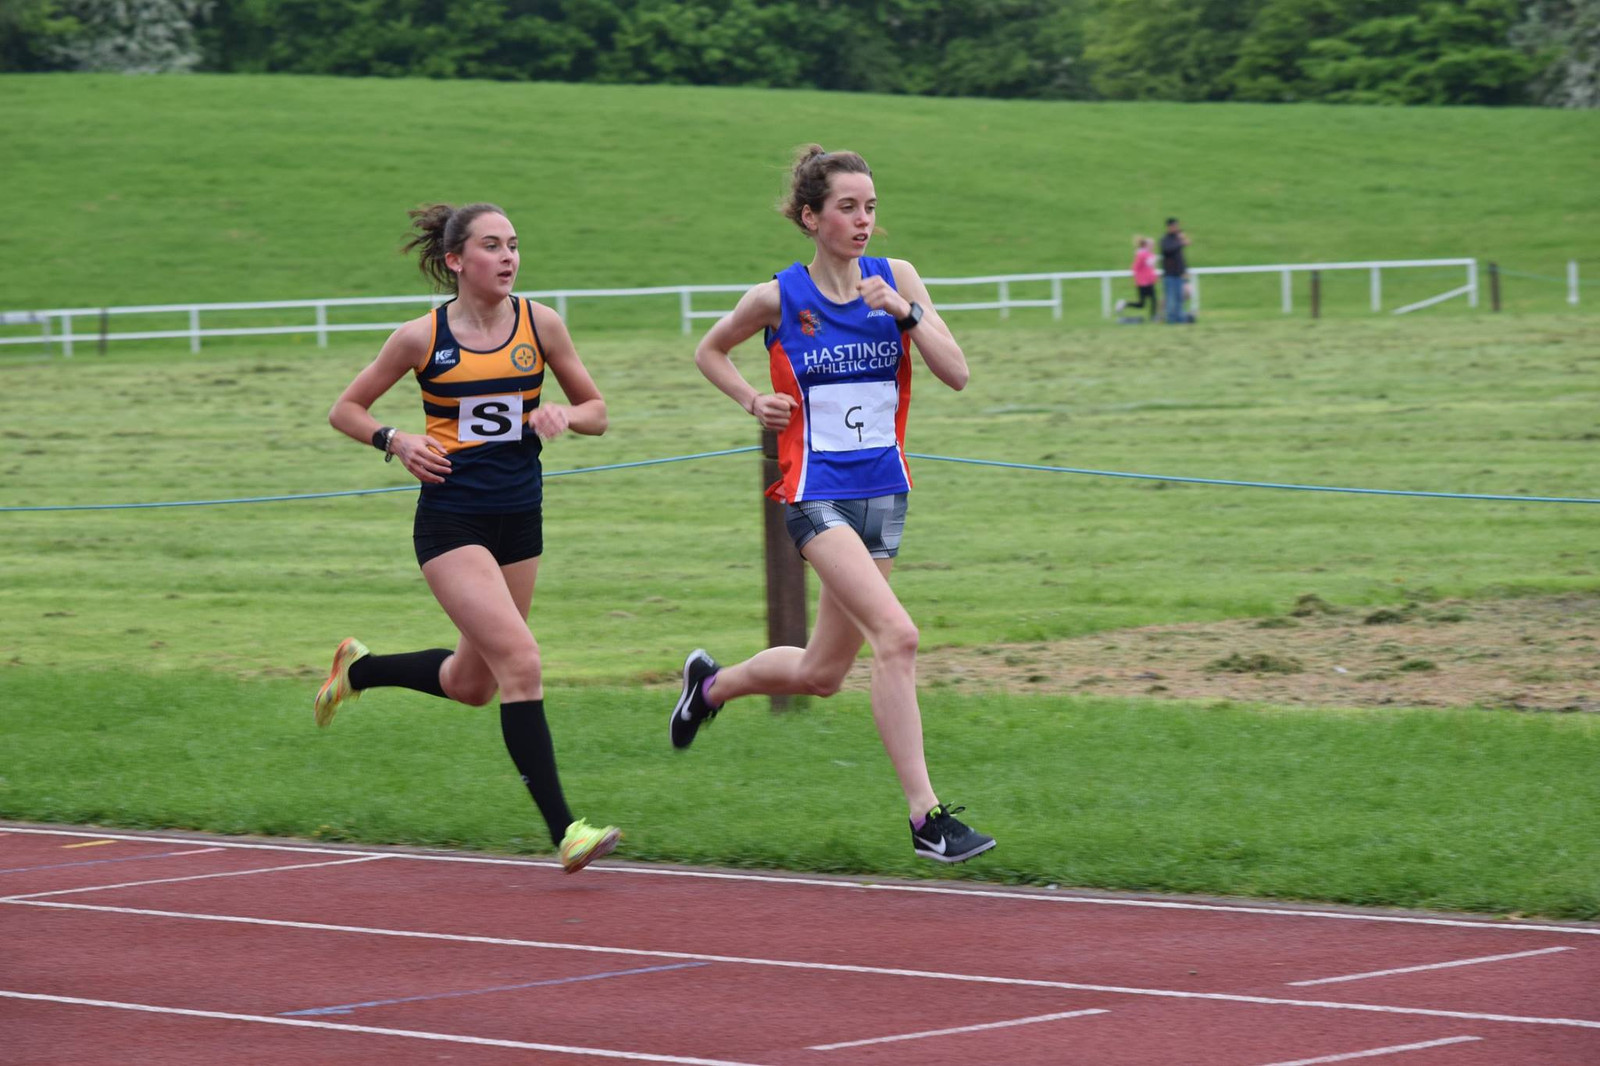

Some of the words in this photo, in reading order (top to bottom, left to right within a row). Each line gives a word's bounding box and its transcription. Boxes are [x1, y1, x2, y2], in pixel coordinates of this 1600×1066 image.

[803, 341, 898, 366] HASTINGS
[806, 359, 867, 375] ATHLETIC
[869, 356, 897, 369] CLUB
[470, 401, 512, 436] S
[845, 406, 864, 442] G
